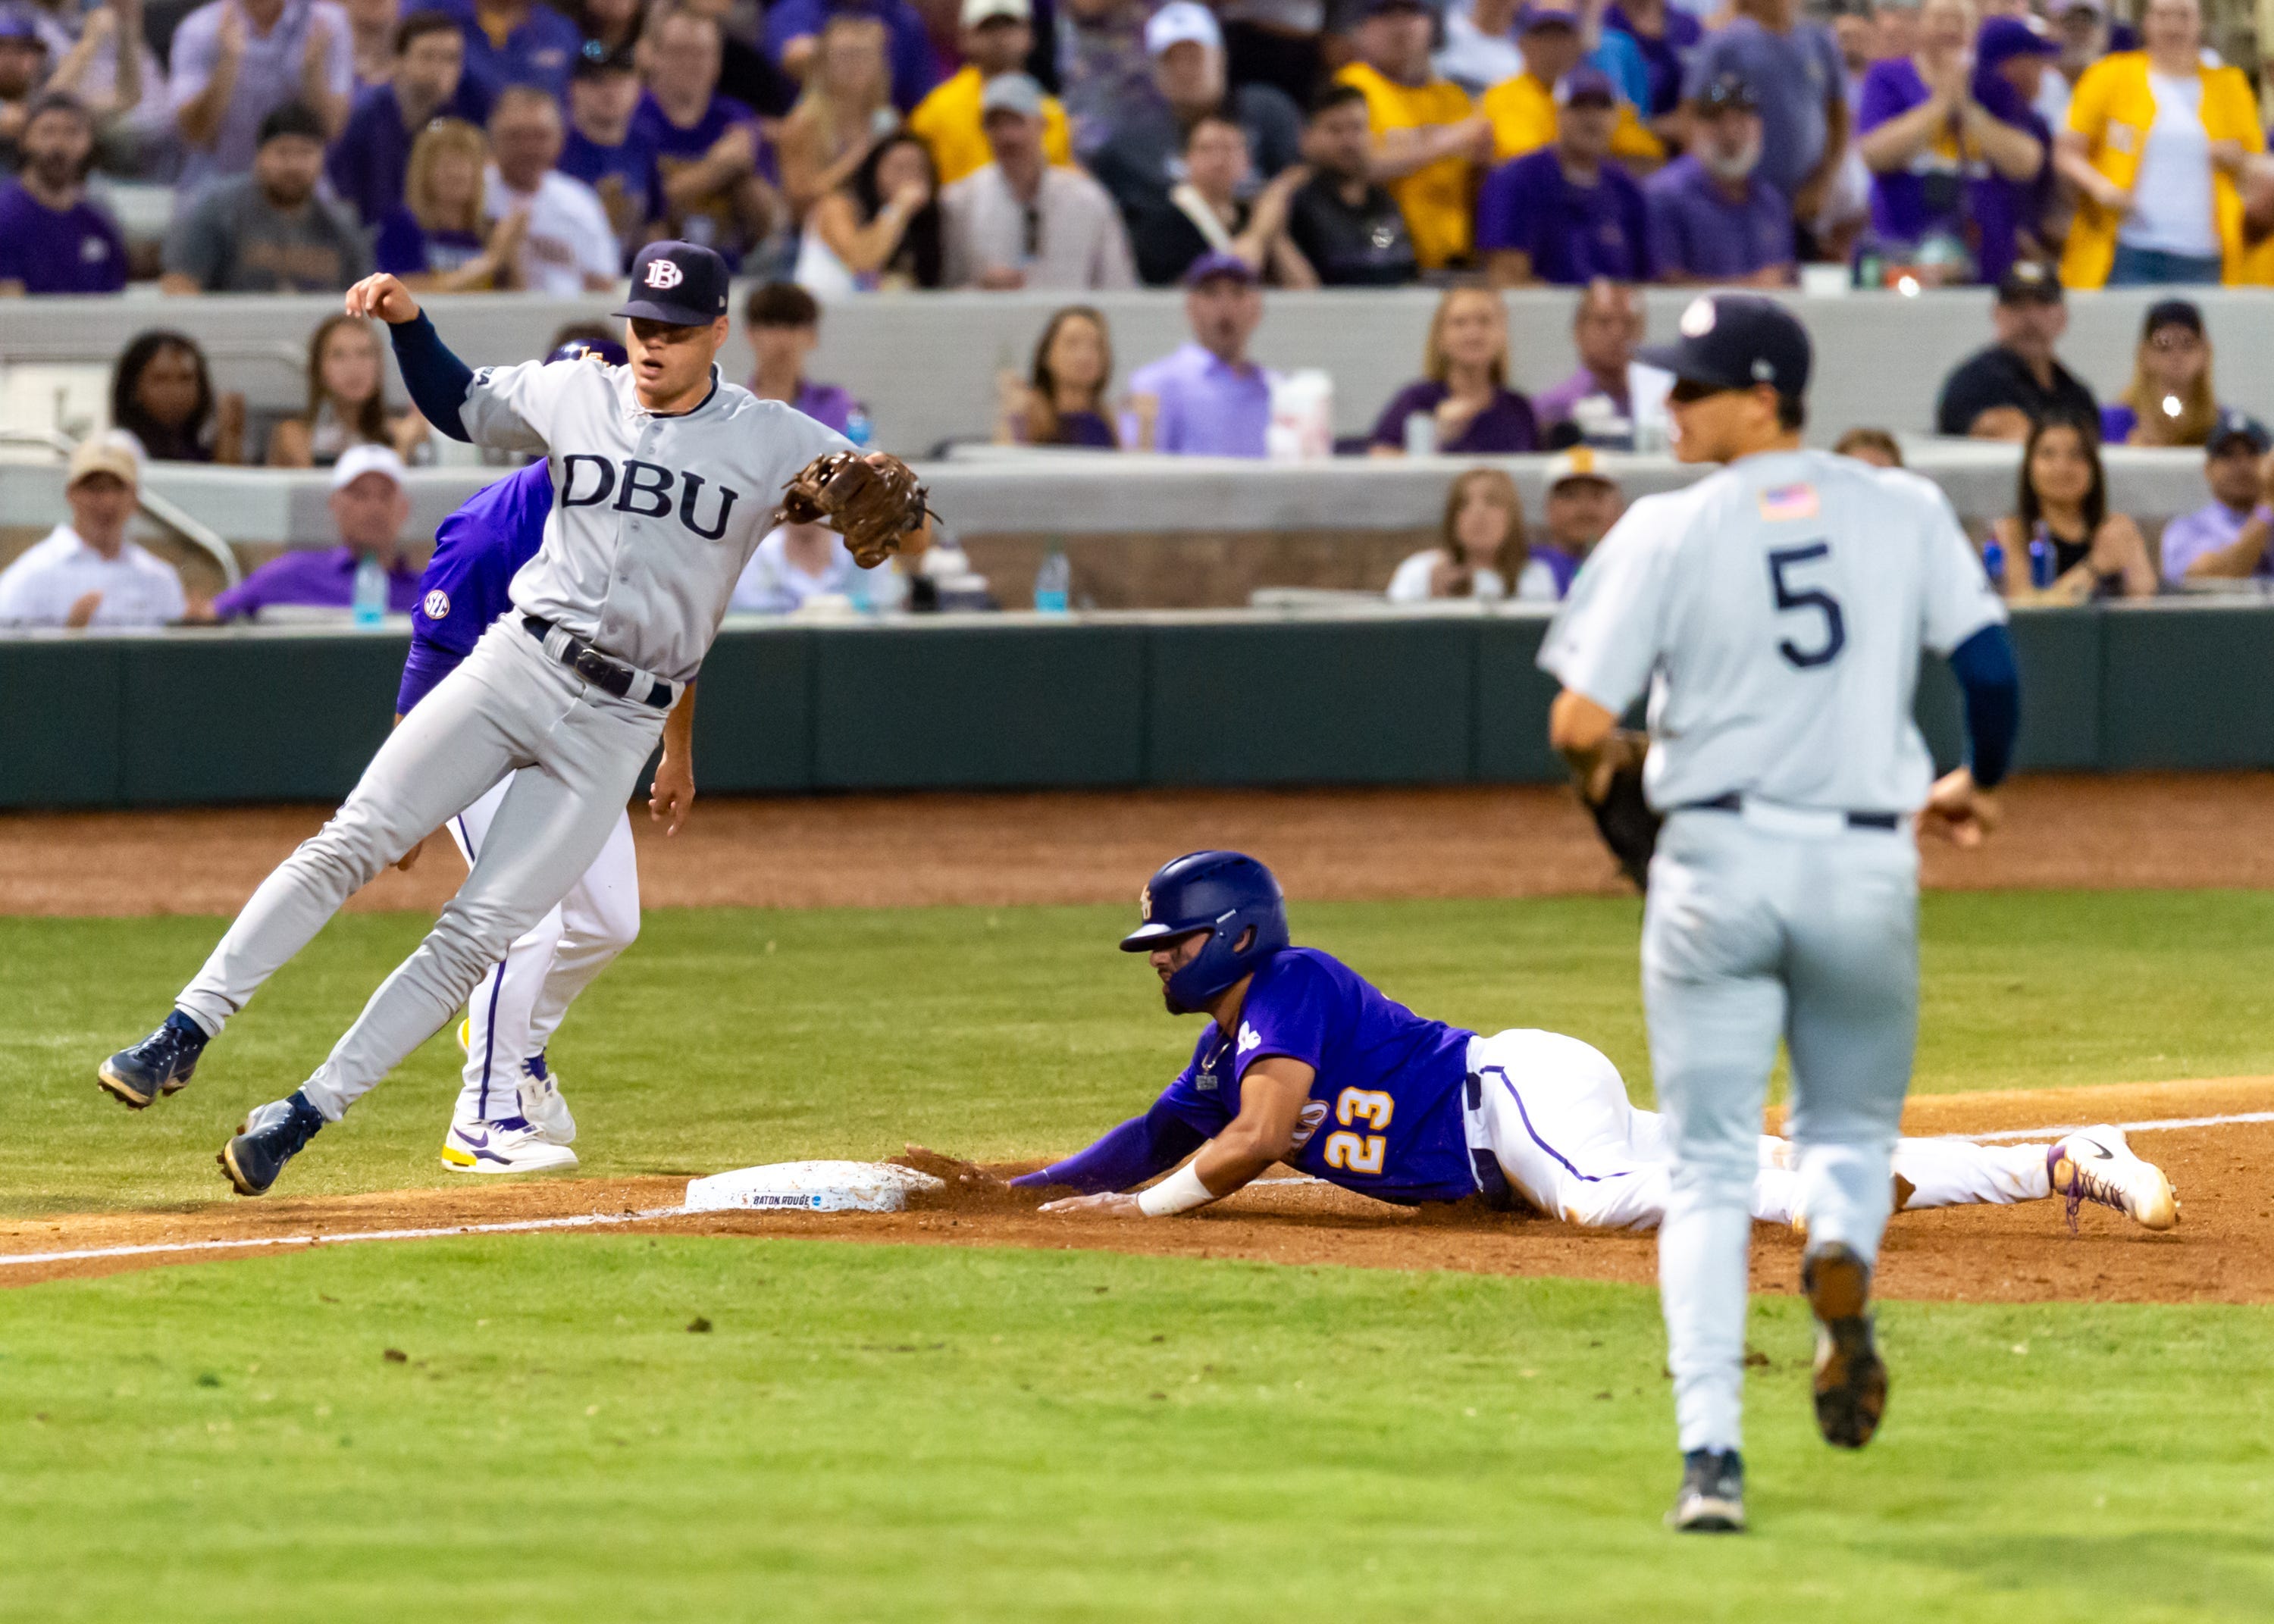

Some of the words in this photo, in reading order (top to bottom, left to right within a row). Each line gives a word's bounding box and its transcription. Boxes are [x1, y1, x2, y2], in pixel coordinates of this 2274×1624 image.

[561, 454, 739, 540] DBU
[425, 591, 449, 618] SEC
[1768, 543, 1846, 667] 5
[1323, 1086, 1395, 1174] 23
[753, 1195, 780, 1205] BATON
[781, 1195, 810, 1206] ROUGE
